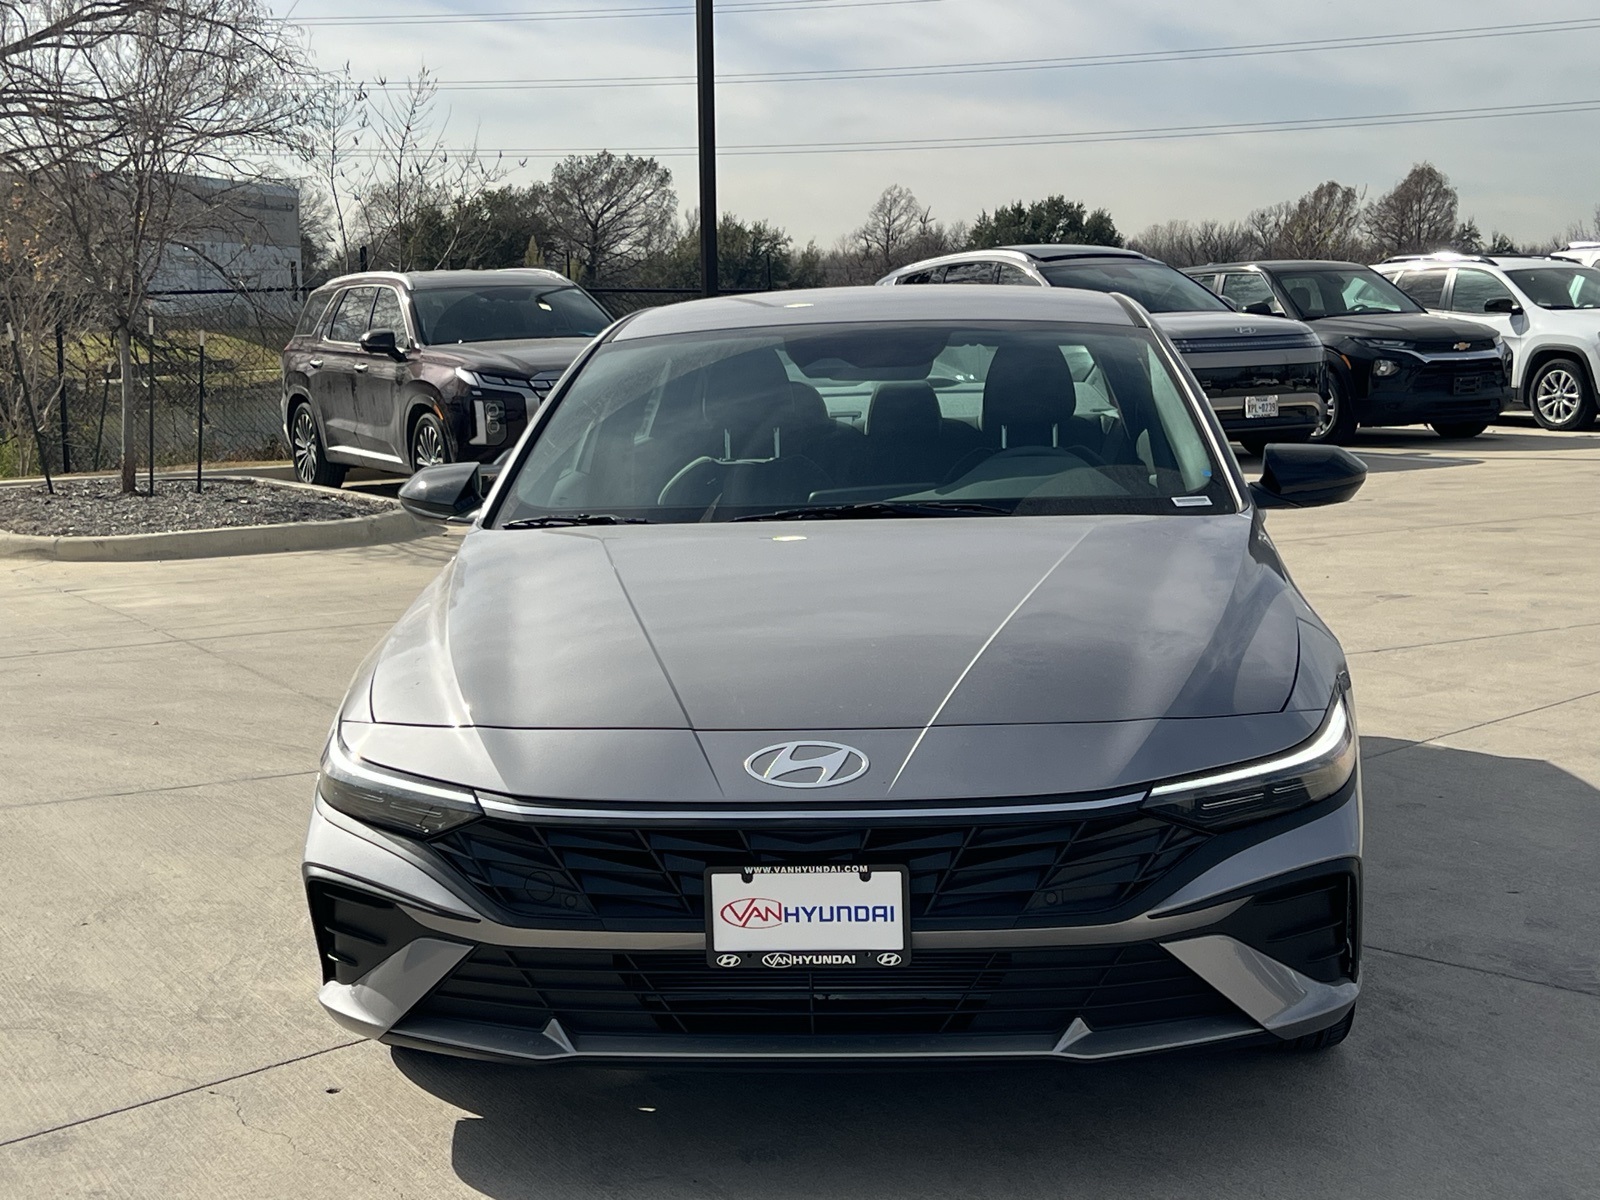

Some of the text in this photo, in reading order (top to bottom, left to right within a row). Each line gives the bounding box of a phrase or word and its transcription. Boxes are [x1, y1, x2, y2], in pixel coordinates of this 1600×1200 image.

[744, 865, 868, 874] WWW.VANHYUNDAI.COM
[784, 905, 895, 923] HYUNDAI
[793, 954, 856, 965] HYUNDAI
